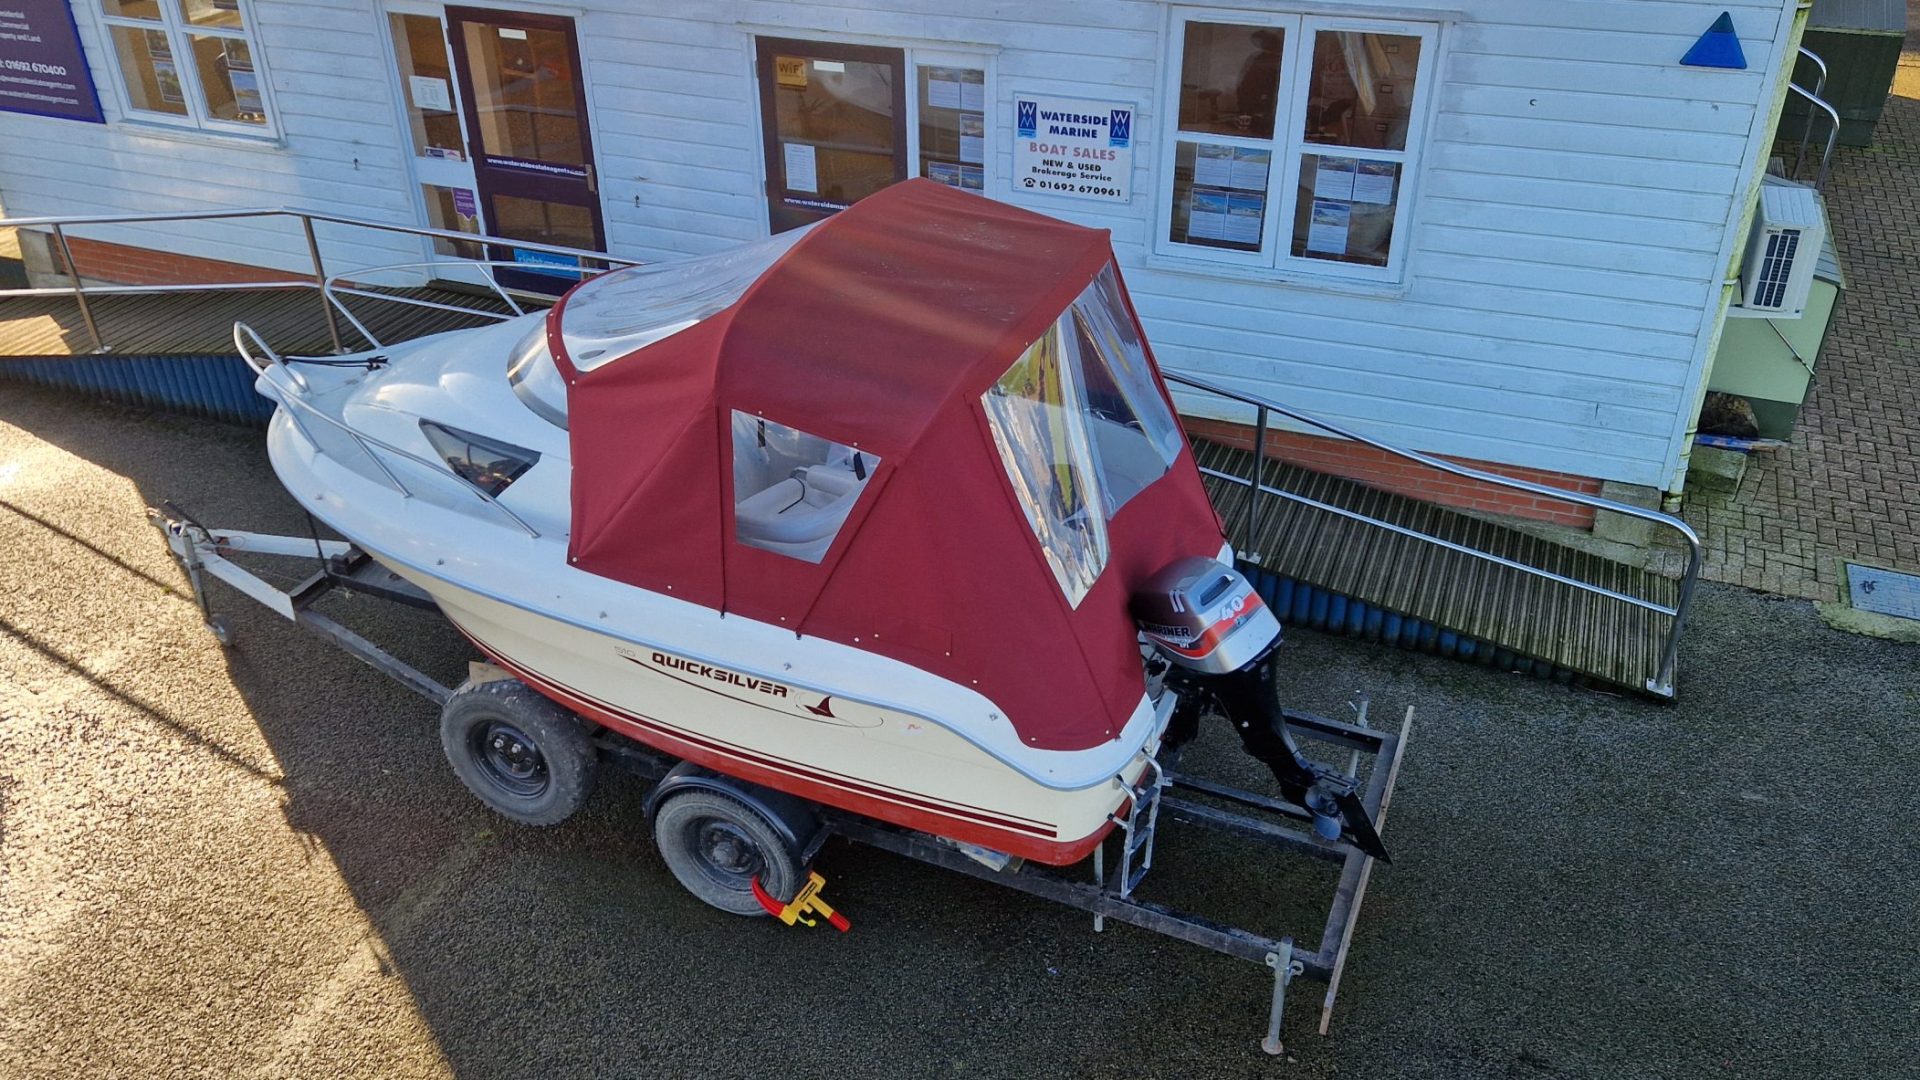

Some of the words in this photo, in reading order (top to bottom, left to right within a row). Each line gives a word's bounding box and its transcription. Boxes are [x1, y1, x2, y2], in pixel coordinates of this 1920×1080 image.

[5, 60, 31, 72] 01692
[31, 63, 67, 76] 670400
[1040, 110, 1108, 126] WATERSIDE
[1049, 125, 1098, 139] MARINE
[1029, 142, 1068, 156] BOAT
[1073, 147, 1116, 161] SALES
[1042, 159, 1063, 168] NEW
[1078, 163, 1101, 172] USED
[1032, 166, 1077, 179] Brokerage
[1080, 172, 1112, 182] Service
[1039, 180, 1075, 192] 01692
[1079, 185, 1121, 197] 670961
[652, 652, 788, 698] QUICKSILVER
